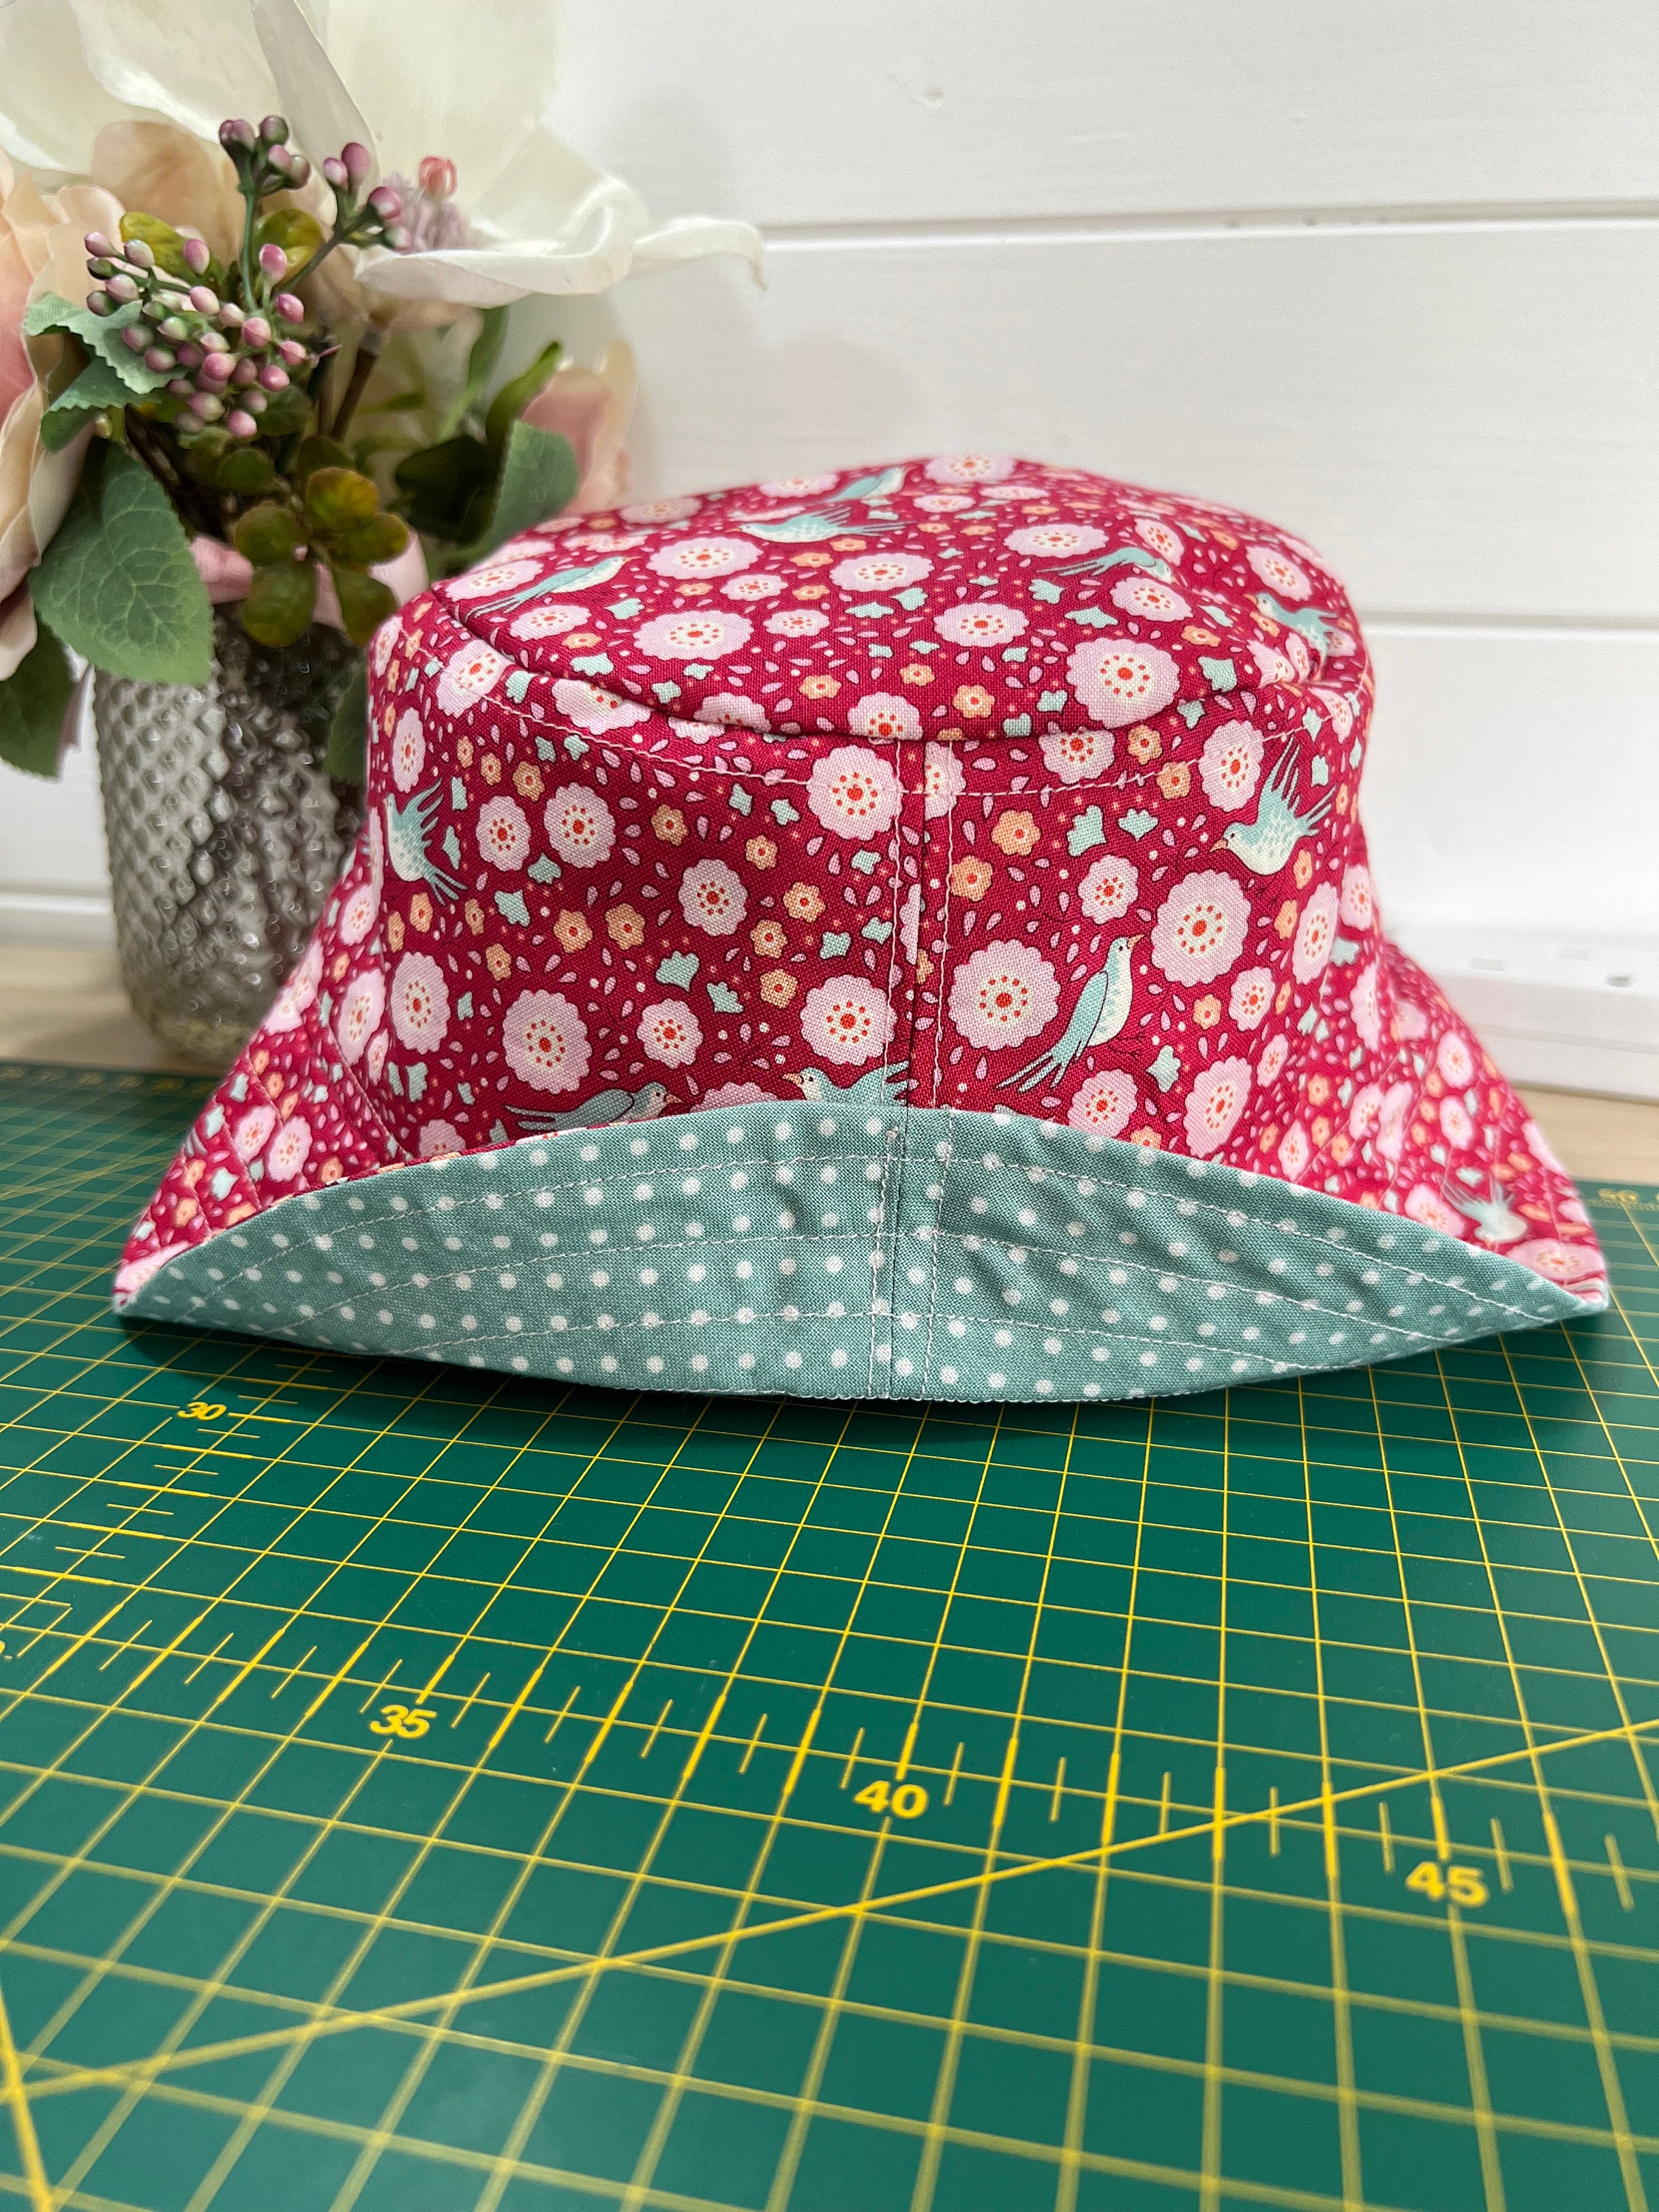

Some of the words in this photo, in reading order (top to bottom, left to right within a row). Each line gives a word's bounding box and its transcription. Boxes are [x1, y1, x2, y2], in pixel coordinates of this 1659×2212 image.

[177, 1402, 227, 1421] 30
[370, 1704, 437, 1739] 35
[854, 1780, 928, 1819] 40
[1405, 1862, 1488, 1907] 45
